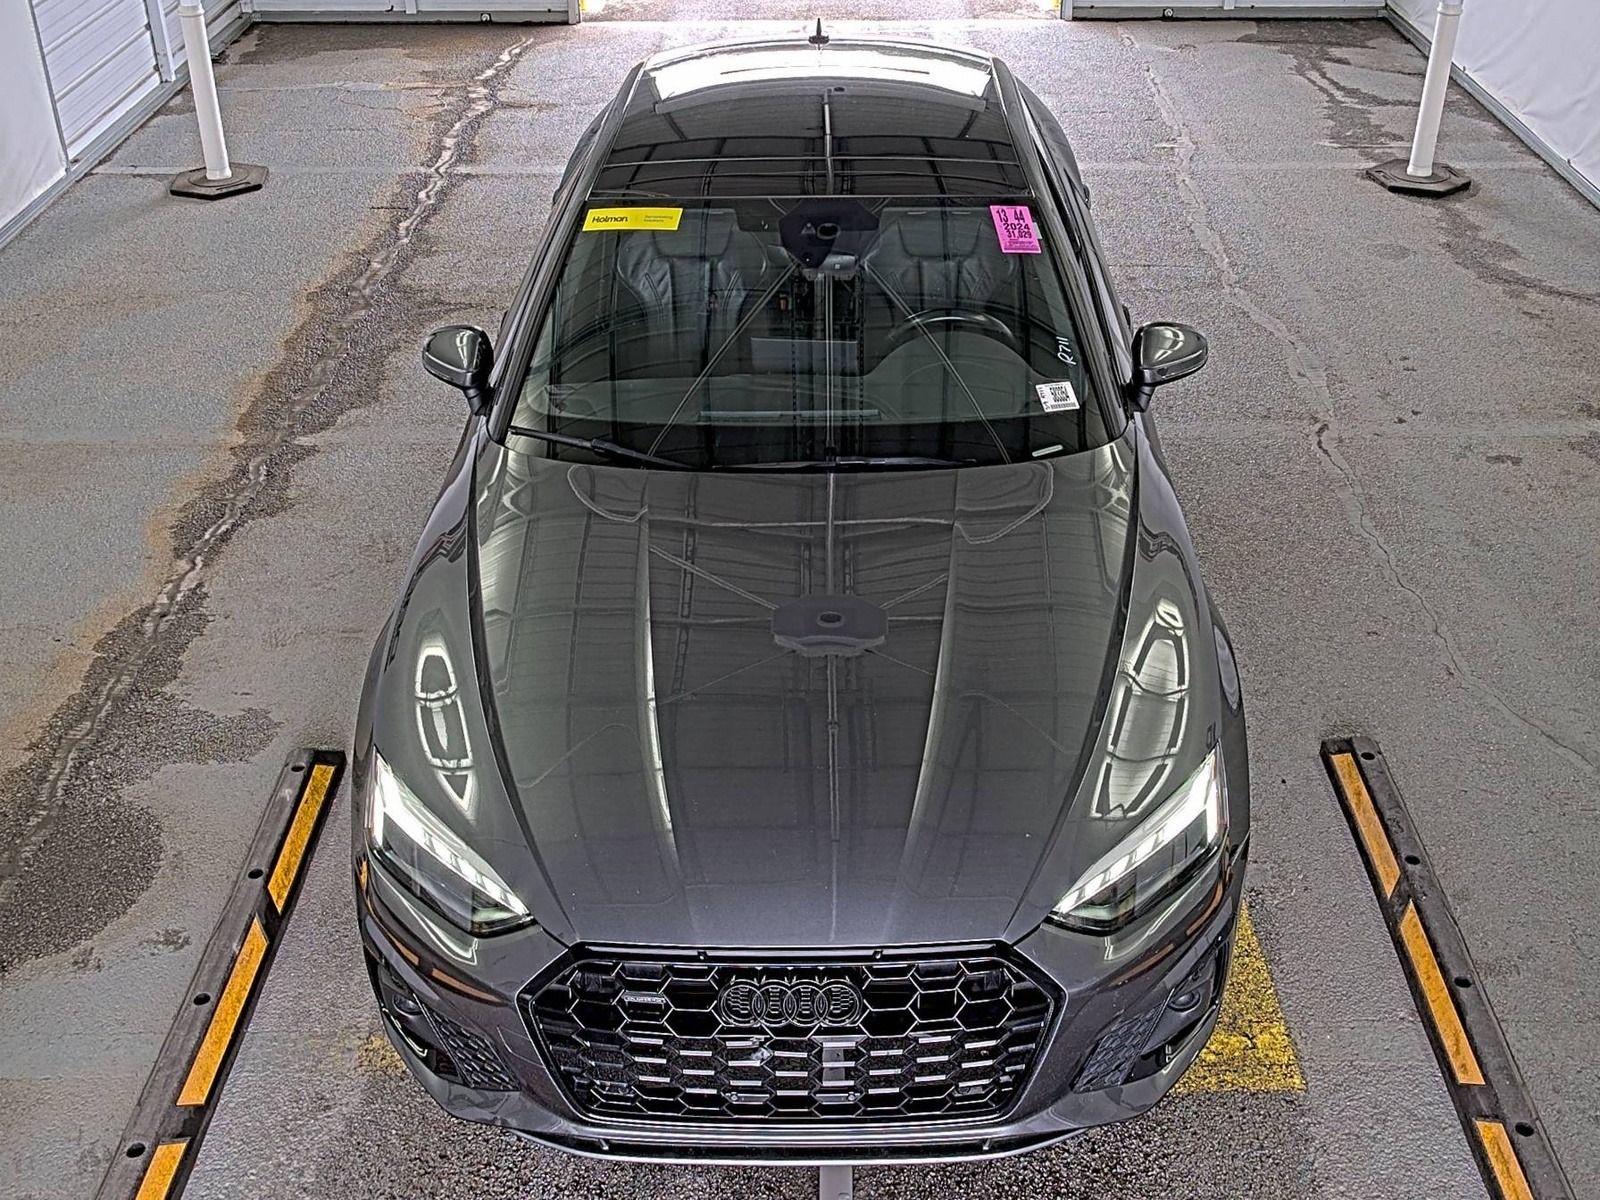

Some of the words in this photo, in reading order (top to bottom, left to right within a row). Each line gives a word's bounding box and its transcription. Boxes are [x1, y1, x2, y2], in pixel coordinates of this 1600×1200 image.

[996, 209, 1009, 223] 13
[1013, 209, 1026, 223] 44
[1003, 223, 1030, 231] 2024
